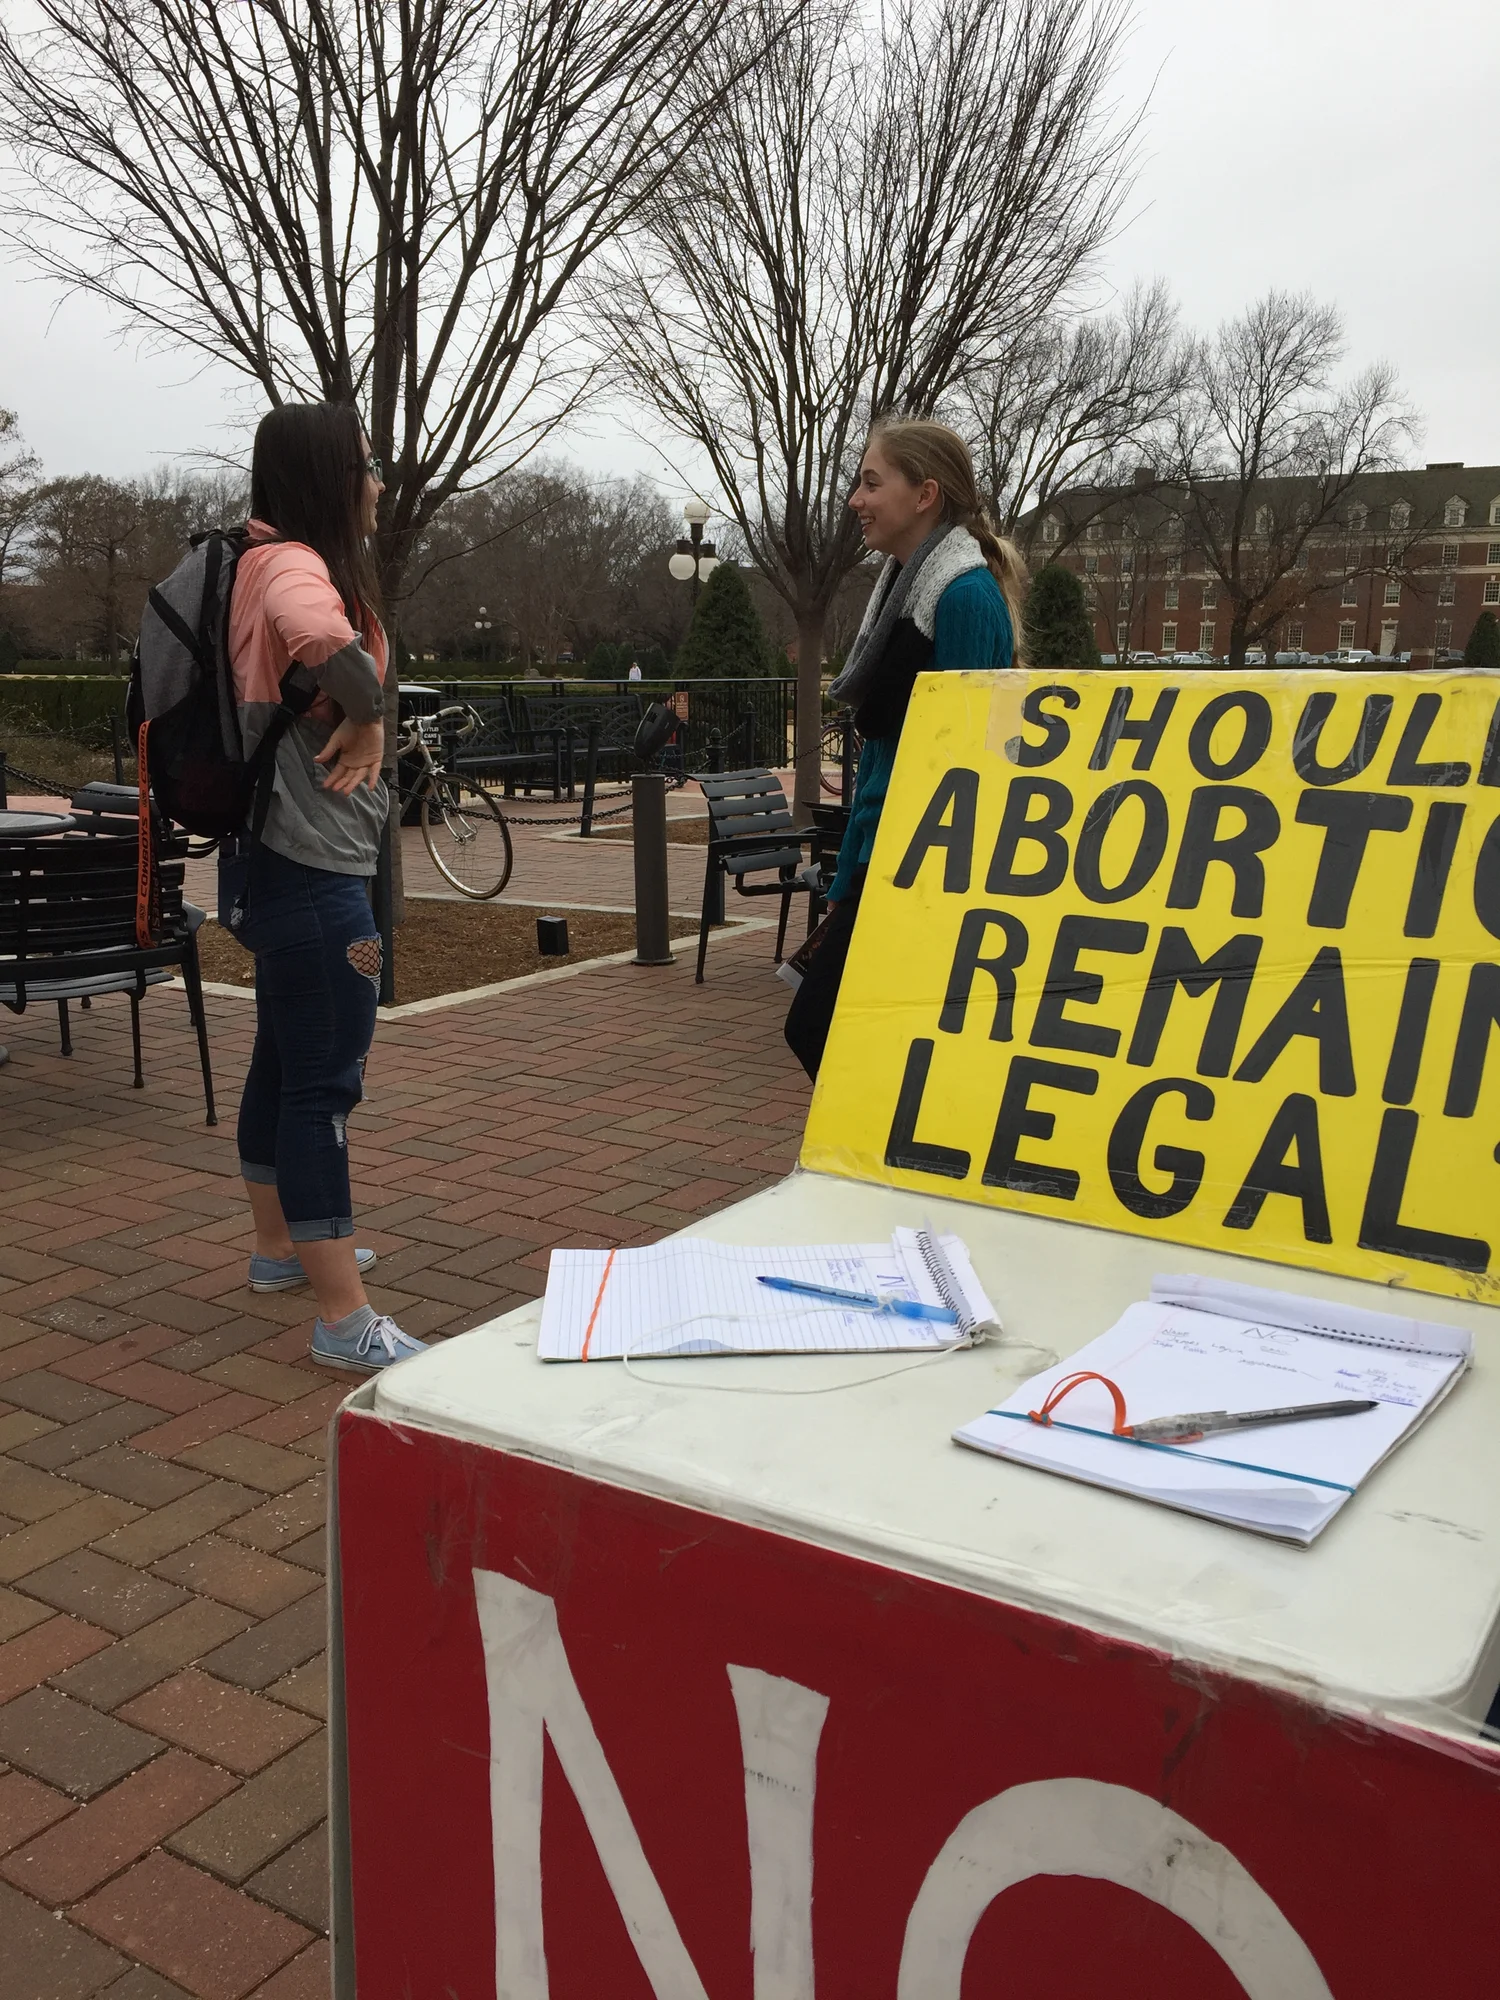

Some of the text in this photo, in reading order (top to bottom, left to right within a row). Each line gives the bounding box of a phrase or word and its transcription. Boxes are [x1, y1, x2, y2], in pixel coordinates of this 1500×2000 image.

[1004, 685, 1500, 788] SHOUL
[140, 815, 148, 898] COWBOYS
[892, 768, 1500, 941] ABORTI
[885, 1038, 1500, 1275] LEGAL
